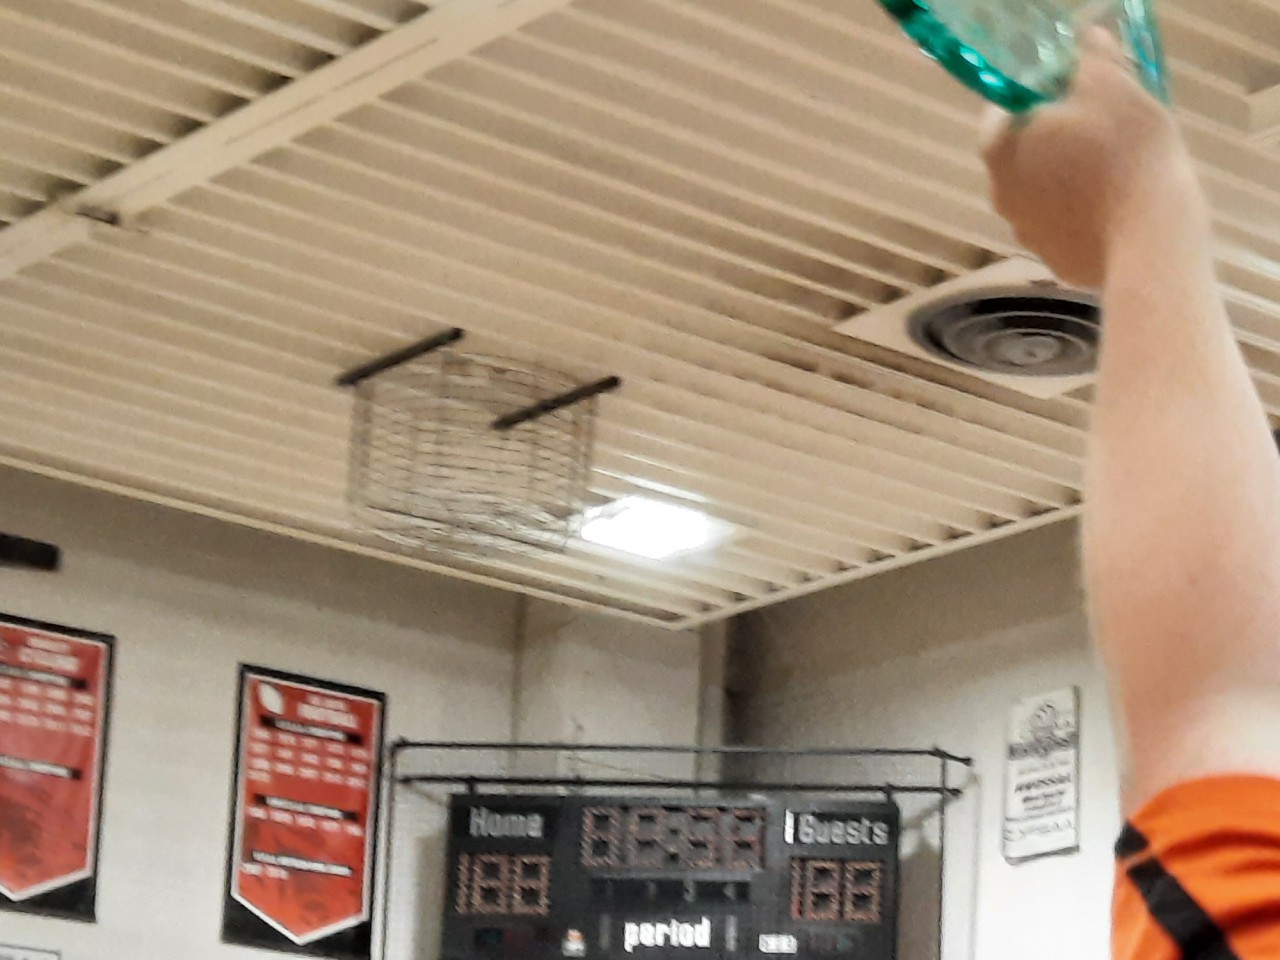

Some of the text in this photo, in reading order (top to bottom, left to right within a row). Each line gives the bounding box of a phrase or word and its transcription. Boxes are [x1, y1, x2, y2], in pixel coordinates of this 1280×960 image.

[469, 806, 544, 839] Home
[798, 813, 889, 845] Guests
[623, 916, 711, 952] period
